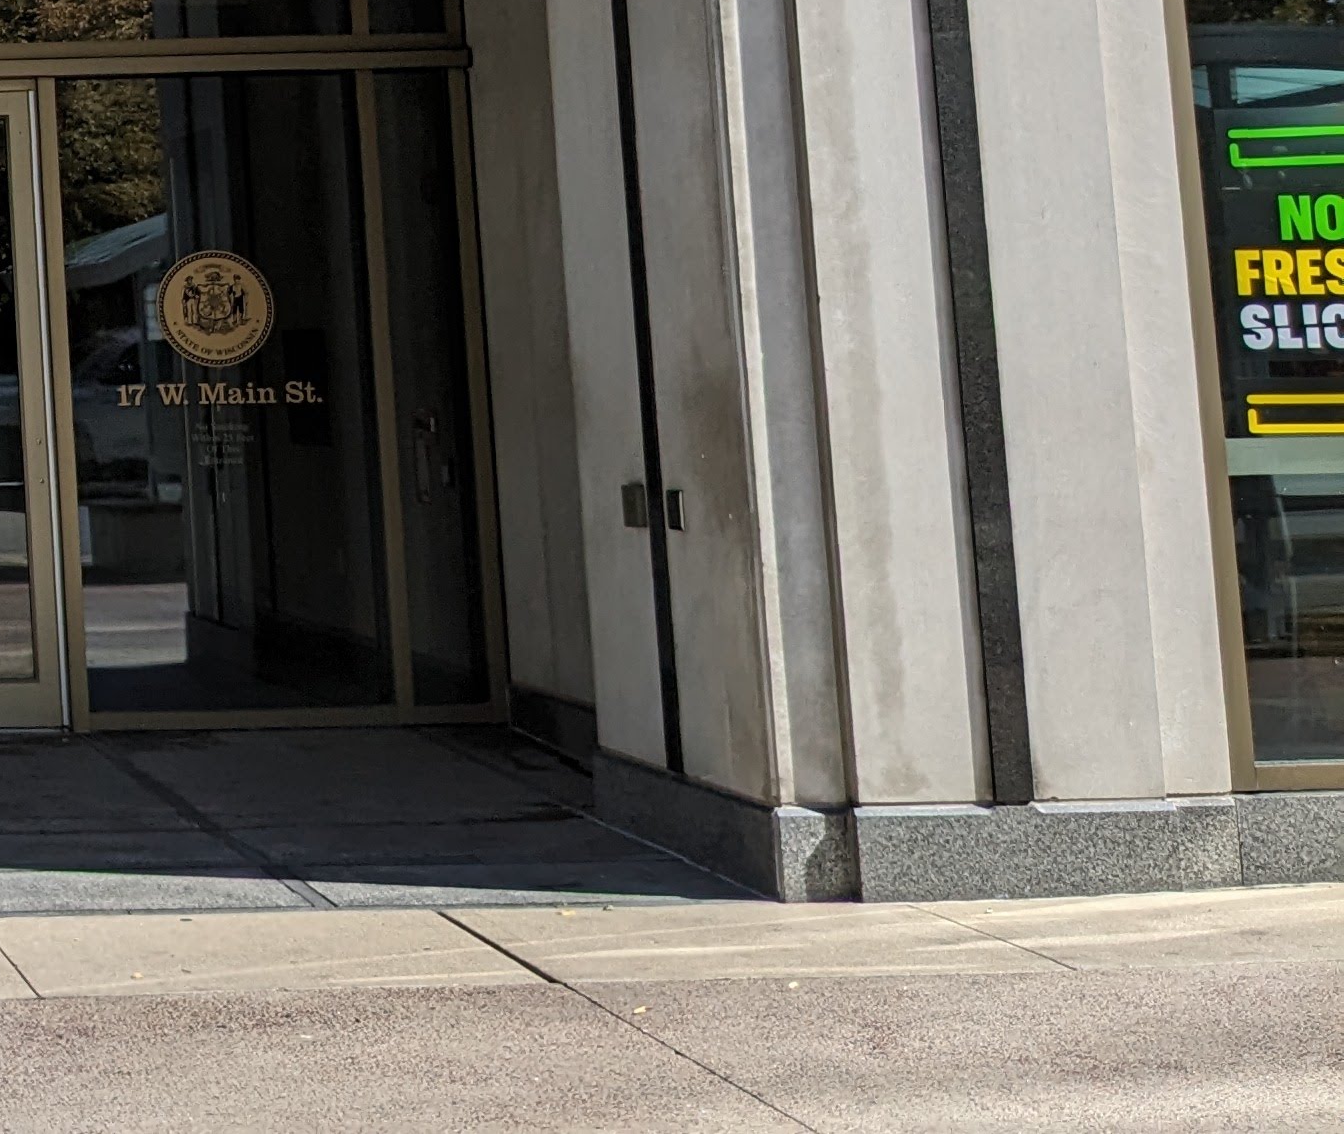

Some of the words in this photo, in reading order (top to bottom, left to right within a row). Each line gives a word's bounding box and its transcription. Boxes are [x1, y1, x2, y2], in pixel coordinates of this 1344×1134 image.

[1278, 194, 1344, 241] NO
[1234, 248, 1344, 296] FRES
[1240, 303, 1344, 350] SLIC
[116, 383, 146, 407] 17
[155, 382, 189, 406] W.
[197, 381, 278, 405] Main
[285, 380, 324, 405] St.
